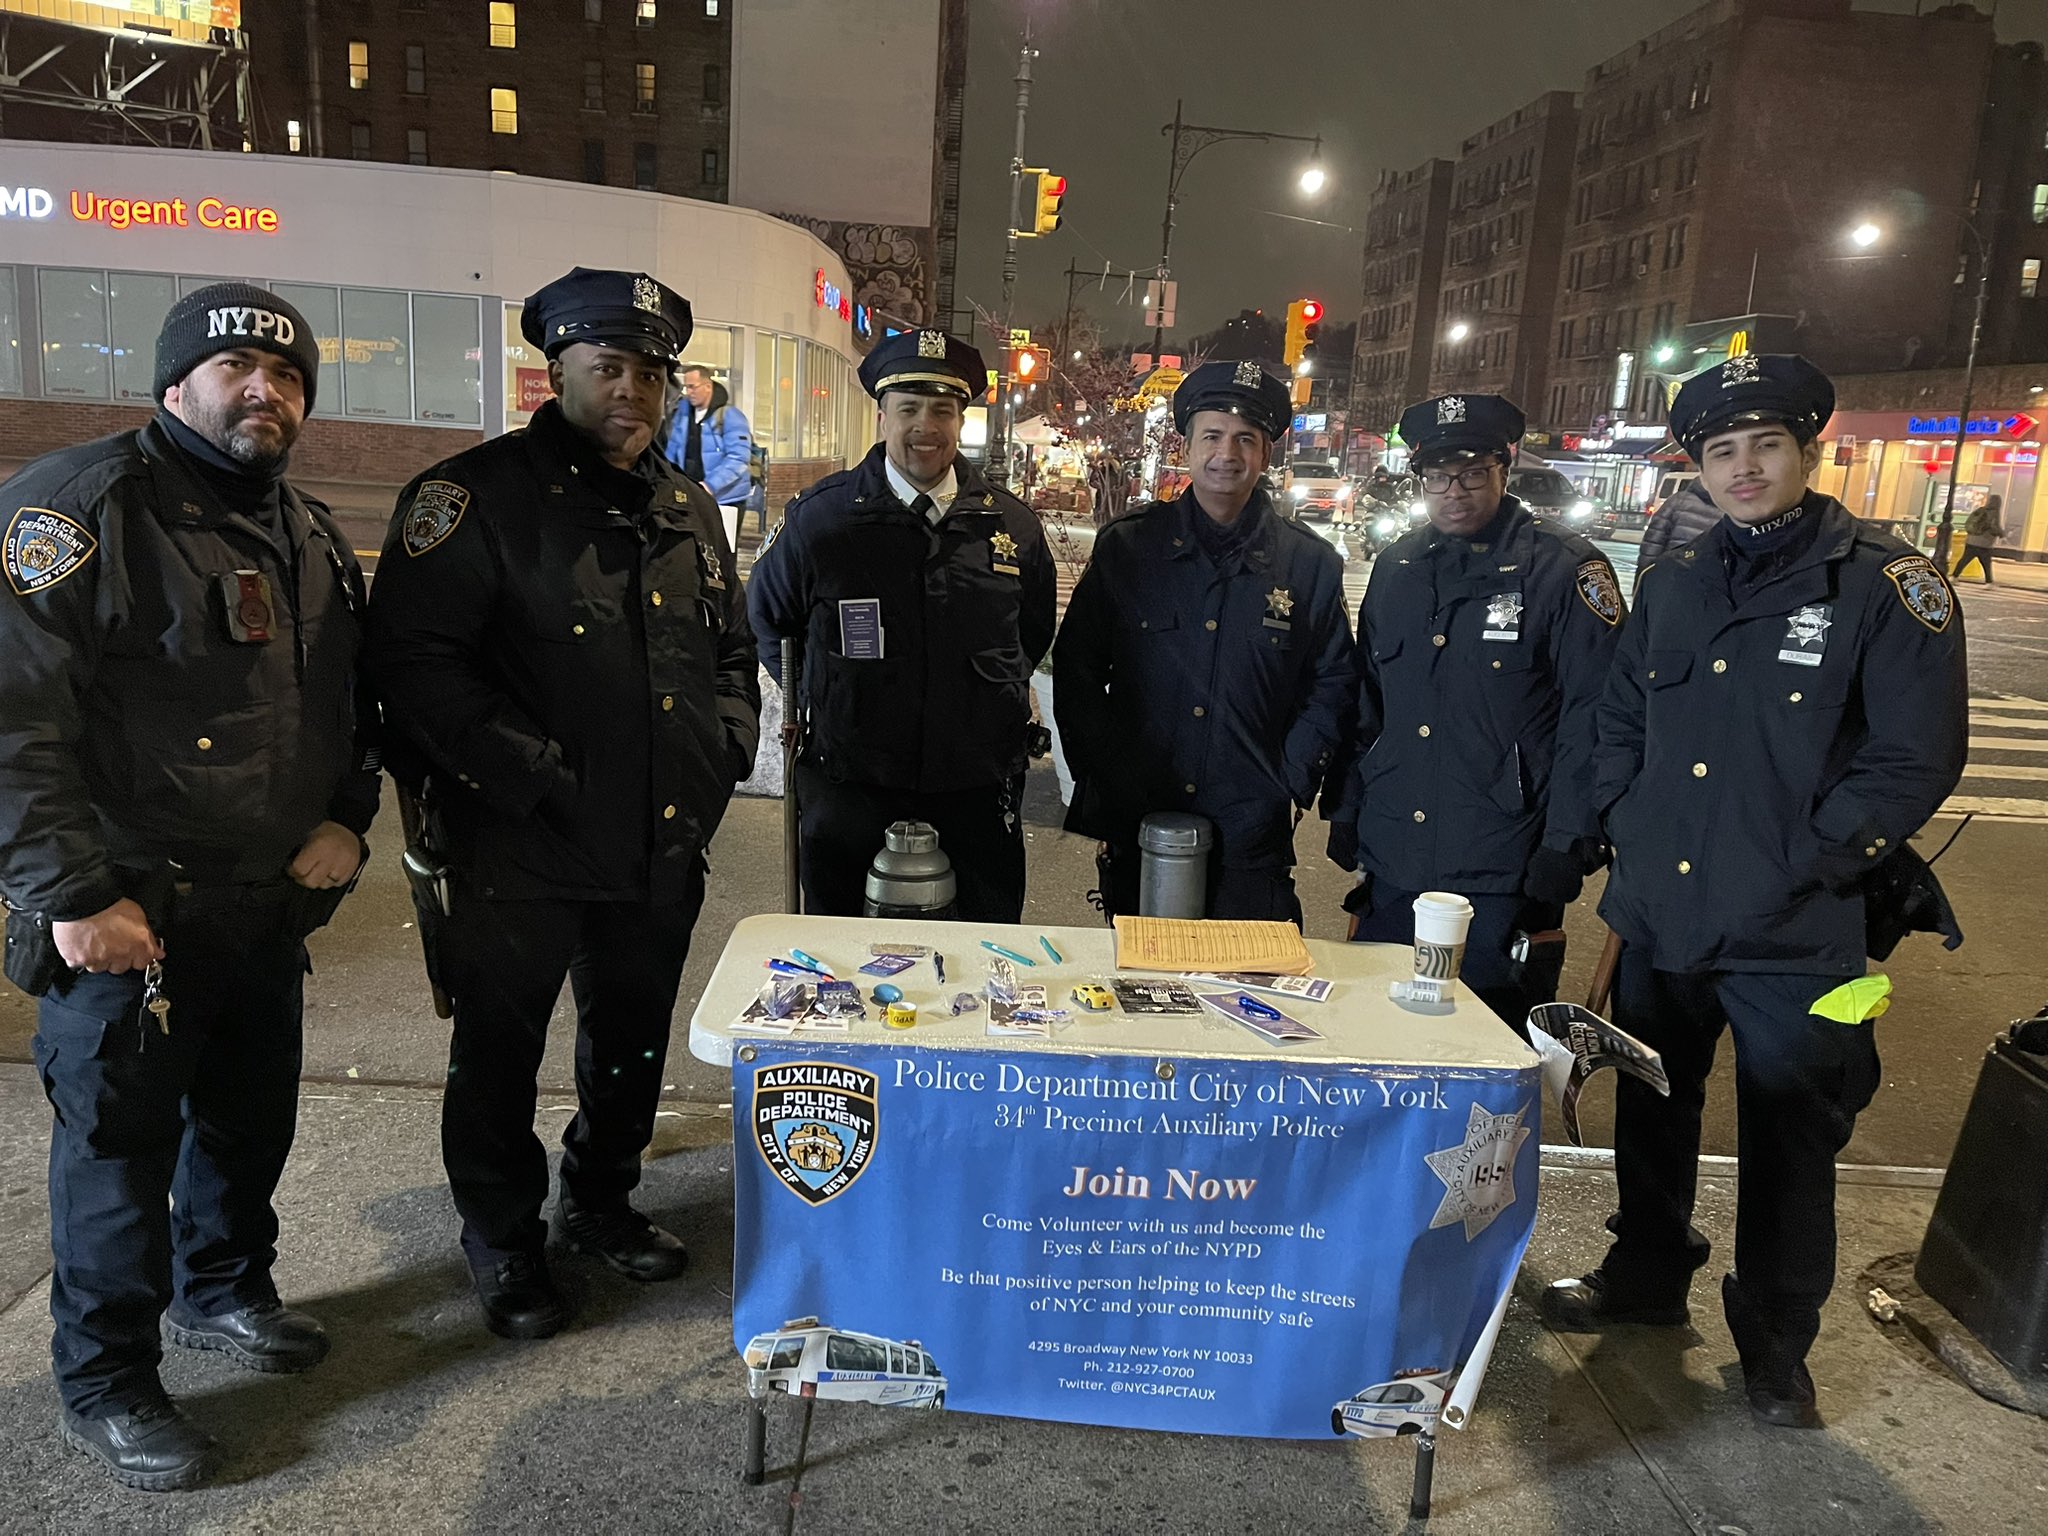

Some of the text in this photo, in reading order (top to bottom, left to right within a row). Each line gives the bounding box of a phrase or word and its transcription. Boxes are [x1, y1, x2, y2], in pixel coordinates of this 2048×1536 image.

[70, 190, 188, 229] Urgent
[197, 197, 278, 232] Care
[207, 306, 296, 346] NYPD
[432, 411, 455, 419] CityMD
[1947, 416, 2002, 435] Aerica
[423, 484, 464, 499] AUXILIARY
[18, 520, 85, 552] DEPARTMENT
[37, 514, 77, 536] POLICE
[7, 537, 19, 576] CITY OF
[30, 555, 79, 587] NEW YORK
[823, 990, 852, 1000] NYC
[1568, 1021, 1592, 1077] RECRUITING
[762, 1067, 871, 1093] AUXILIARY
[893, 1059, 1449, 1110] Police Department City of New York
[783, 1091, 848, 1111] POLICE
[759, 1104, 872, 1135] DEPARTMENT
[994, 1103, 1344, 1141] 34th Precinct Auxiliary Police
[761, 1133, 800, 1184] CITY OF
[1458, 1129, 1510, 1173] AUXILIARY
[822, 1139, 871, 1196] NEW YORK
[1062, 1166, 1257, 1201] Join Now
[1454, 1180, 1466, 1203] CITY
[982, 1213, 1326, 1240] Come Volunteer with us and become the
[1042, 1239, 1262, 1259] Eyes & Ears of the NYPD
[941, 1268, 1356, 1309] Be that positive person helping to keep the streets
[1030, 1297, 1314, 1328] of NYC and your community safe
[1028, 1341, 1253, 1365] 4295 Broadway New York NY 10033
[831, 1371, 878, 1381] AUXILIARY
[1084, 1361, 1195, 1379] Ph. 212-927-0700
[1058, 1378, 1216, 1400] Twitter. @NYC34PCTAUX
[1346, 1406, 1364, 1418] NYPD
